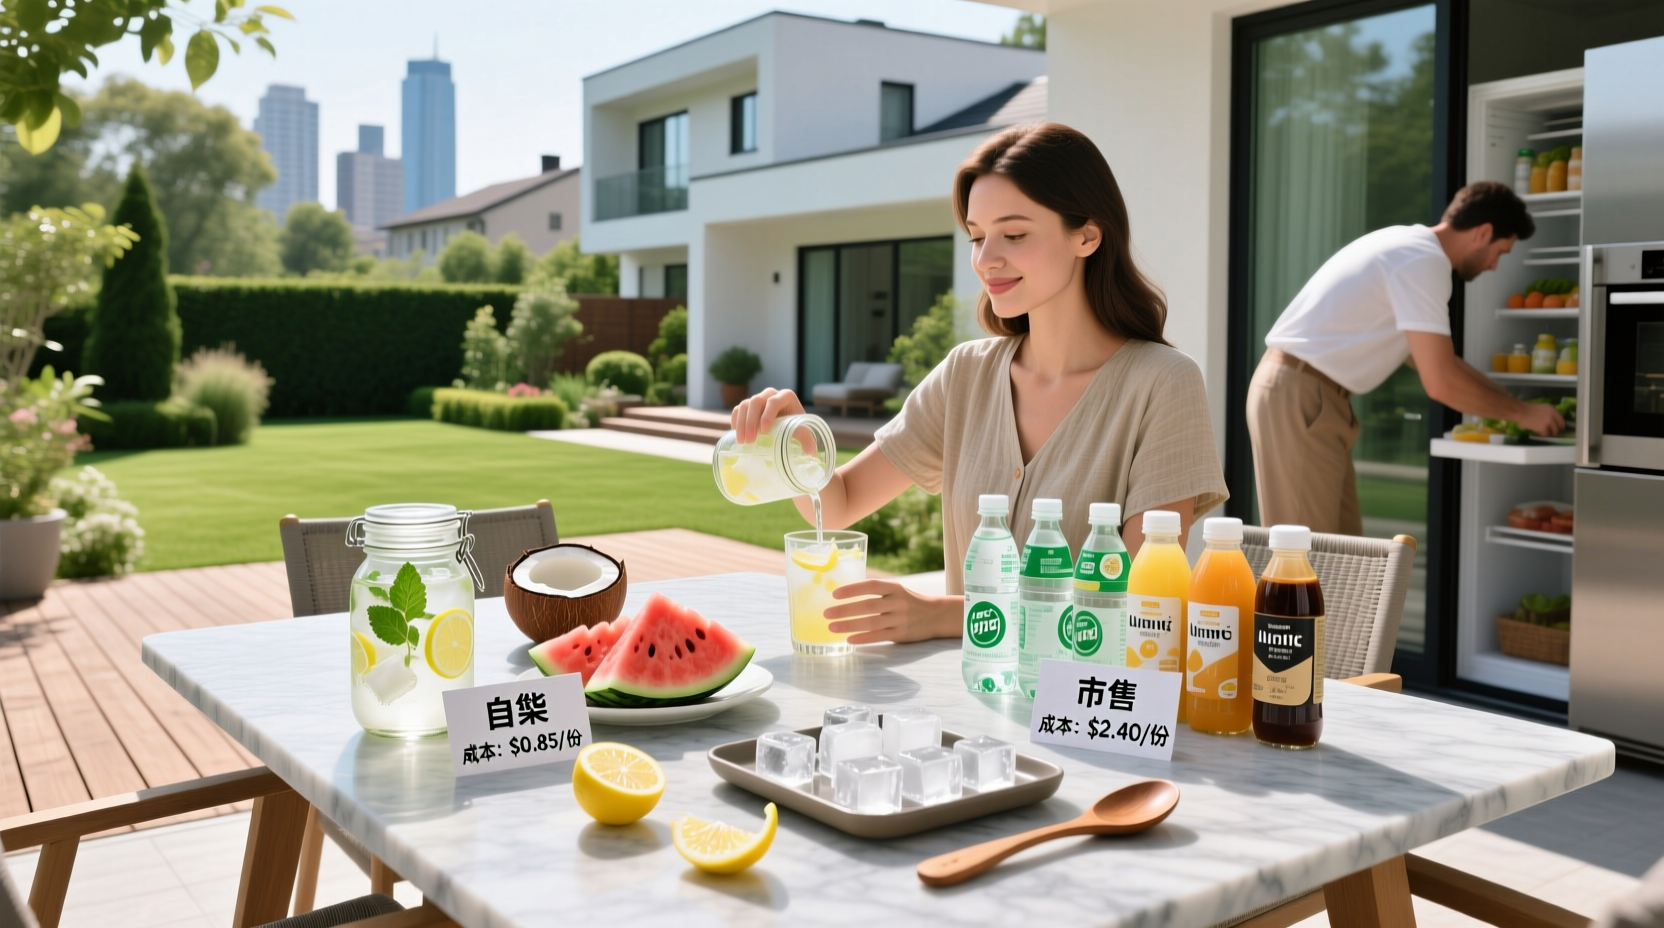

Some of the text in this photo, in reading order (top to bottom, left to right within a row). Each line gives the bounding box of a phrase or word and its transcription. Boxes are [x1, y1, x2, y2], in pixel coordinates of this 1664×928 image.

[1077, 676, 1137, 712] 市售
[509, 728, 582, 758] $0.85/份
[1087, 716, 1169, 747] $2.40/份
